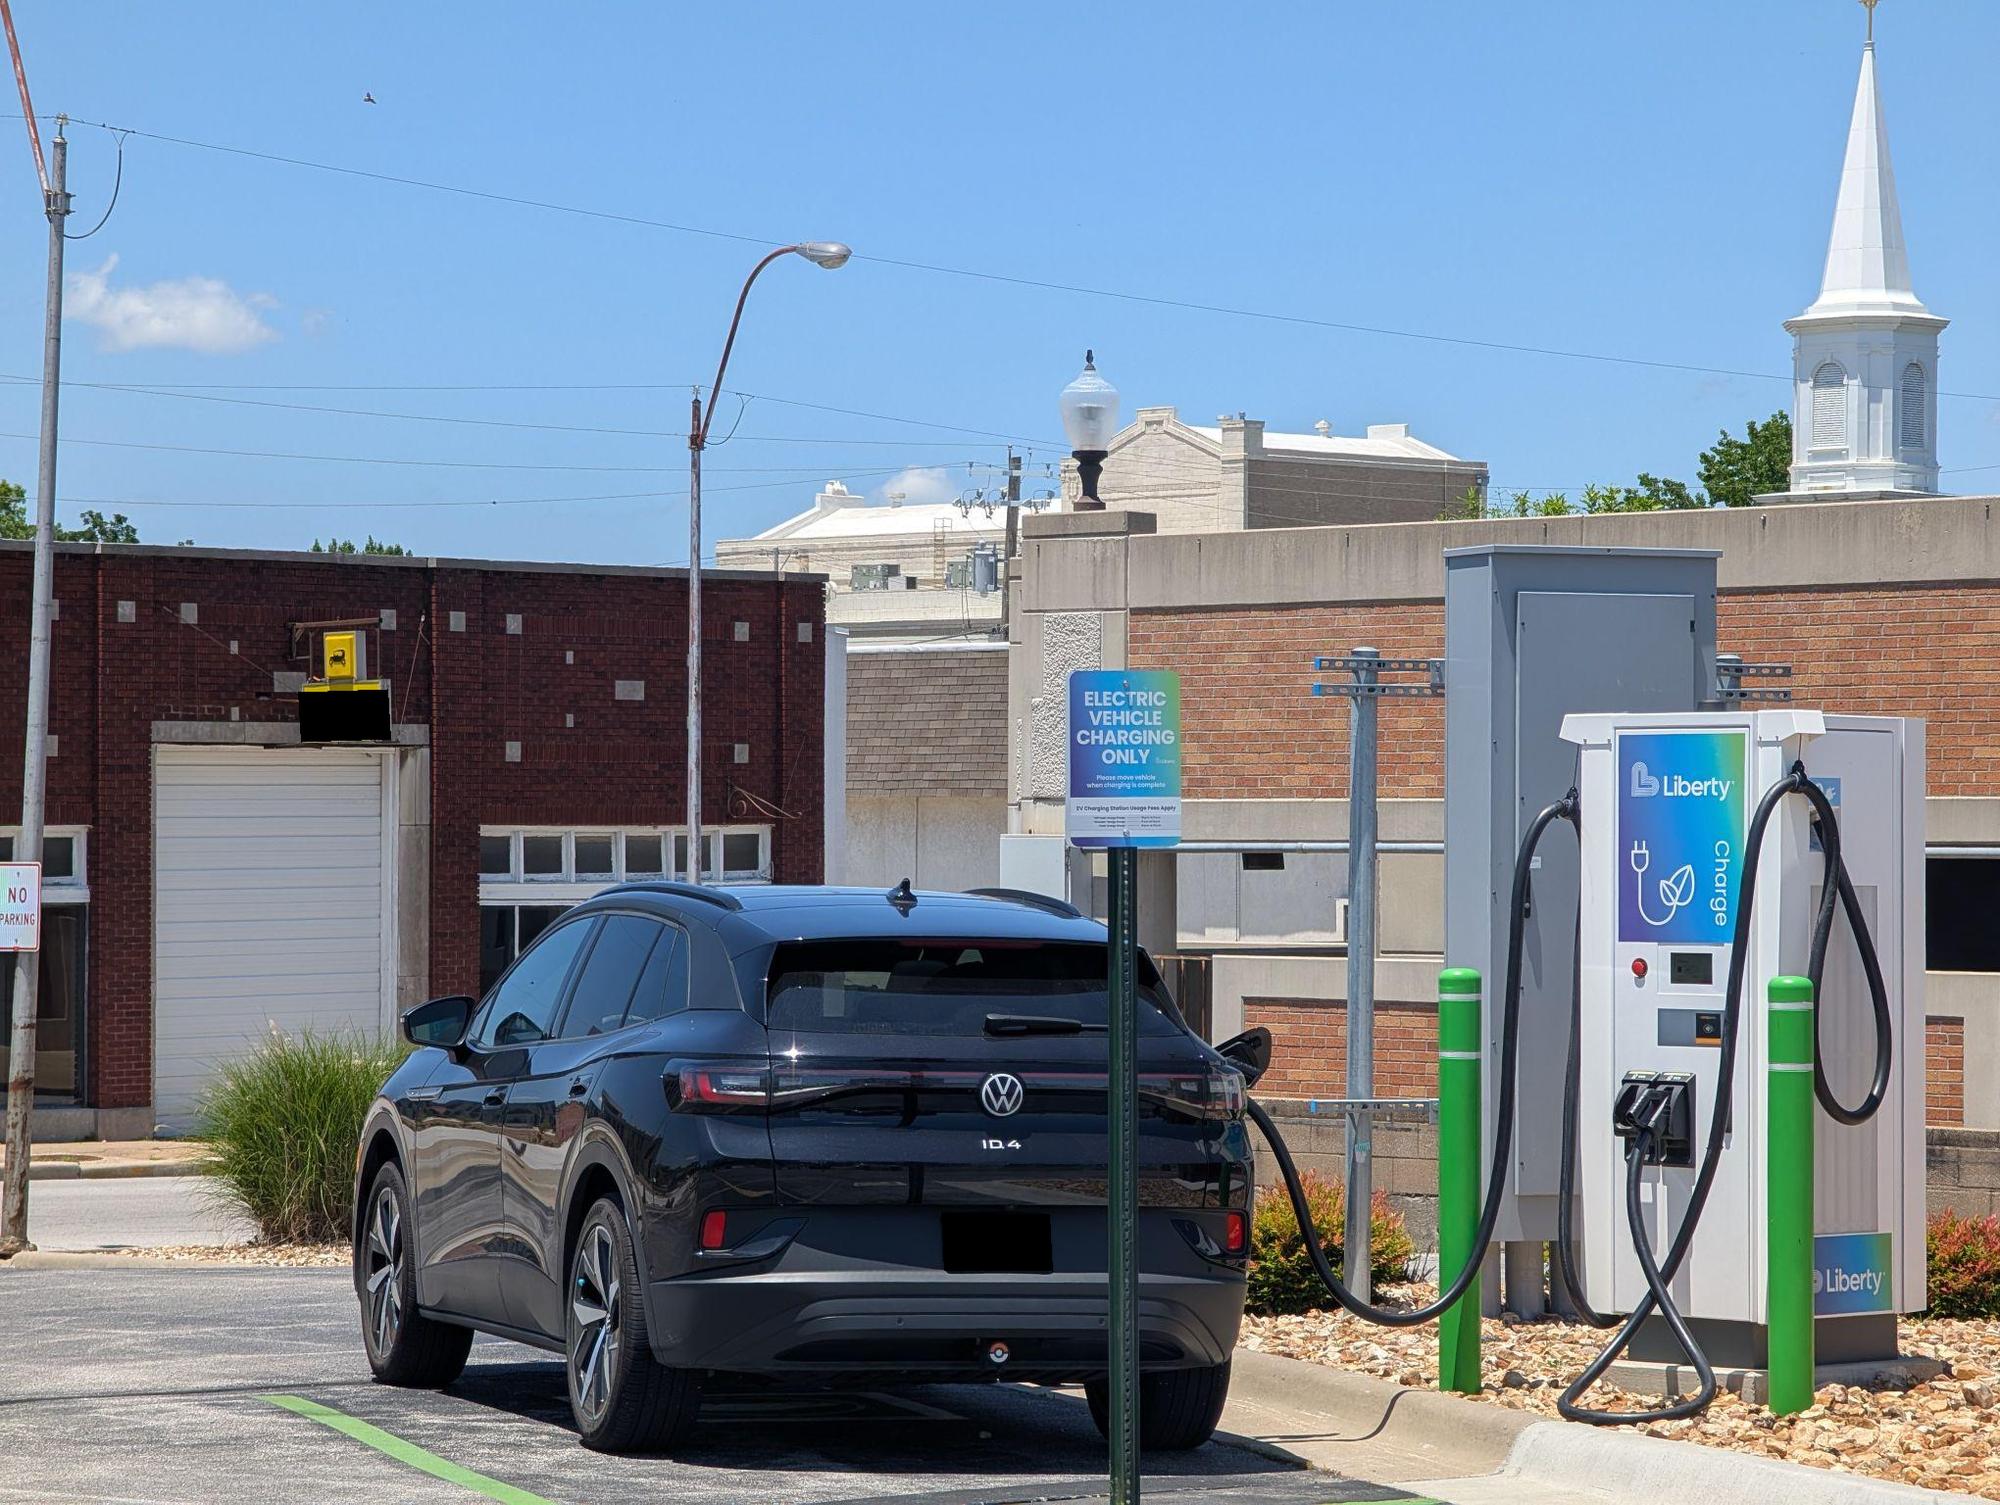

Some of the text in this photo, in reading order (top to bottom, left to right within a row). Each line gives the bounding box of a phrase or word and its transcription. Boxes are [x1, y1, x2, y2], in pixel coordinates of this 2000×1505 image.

[1084, 691, 1167, 707] ELECTRIC
[1089, 711, 1162, 726] VEHICLE
[1076, 730, 1175, 745] CHARGING
[1102, 749, 1151, 764] ONLY
[1663, 775, 1731, 801] Liberty
[1710, 840, 1730, 926] Charge
[8, 887, 28, 903] NO
[0, 913, 35, 926] PARKING
[1826, 1268, 1883, 1296] Liberty
